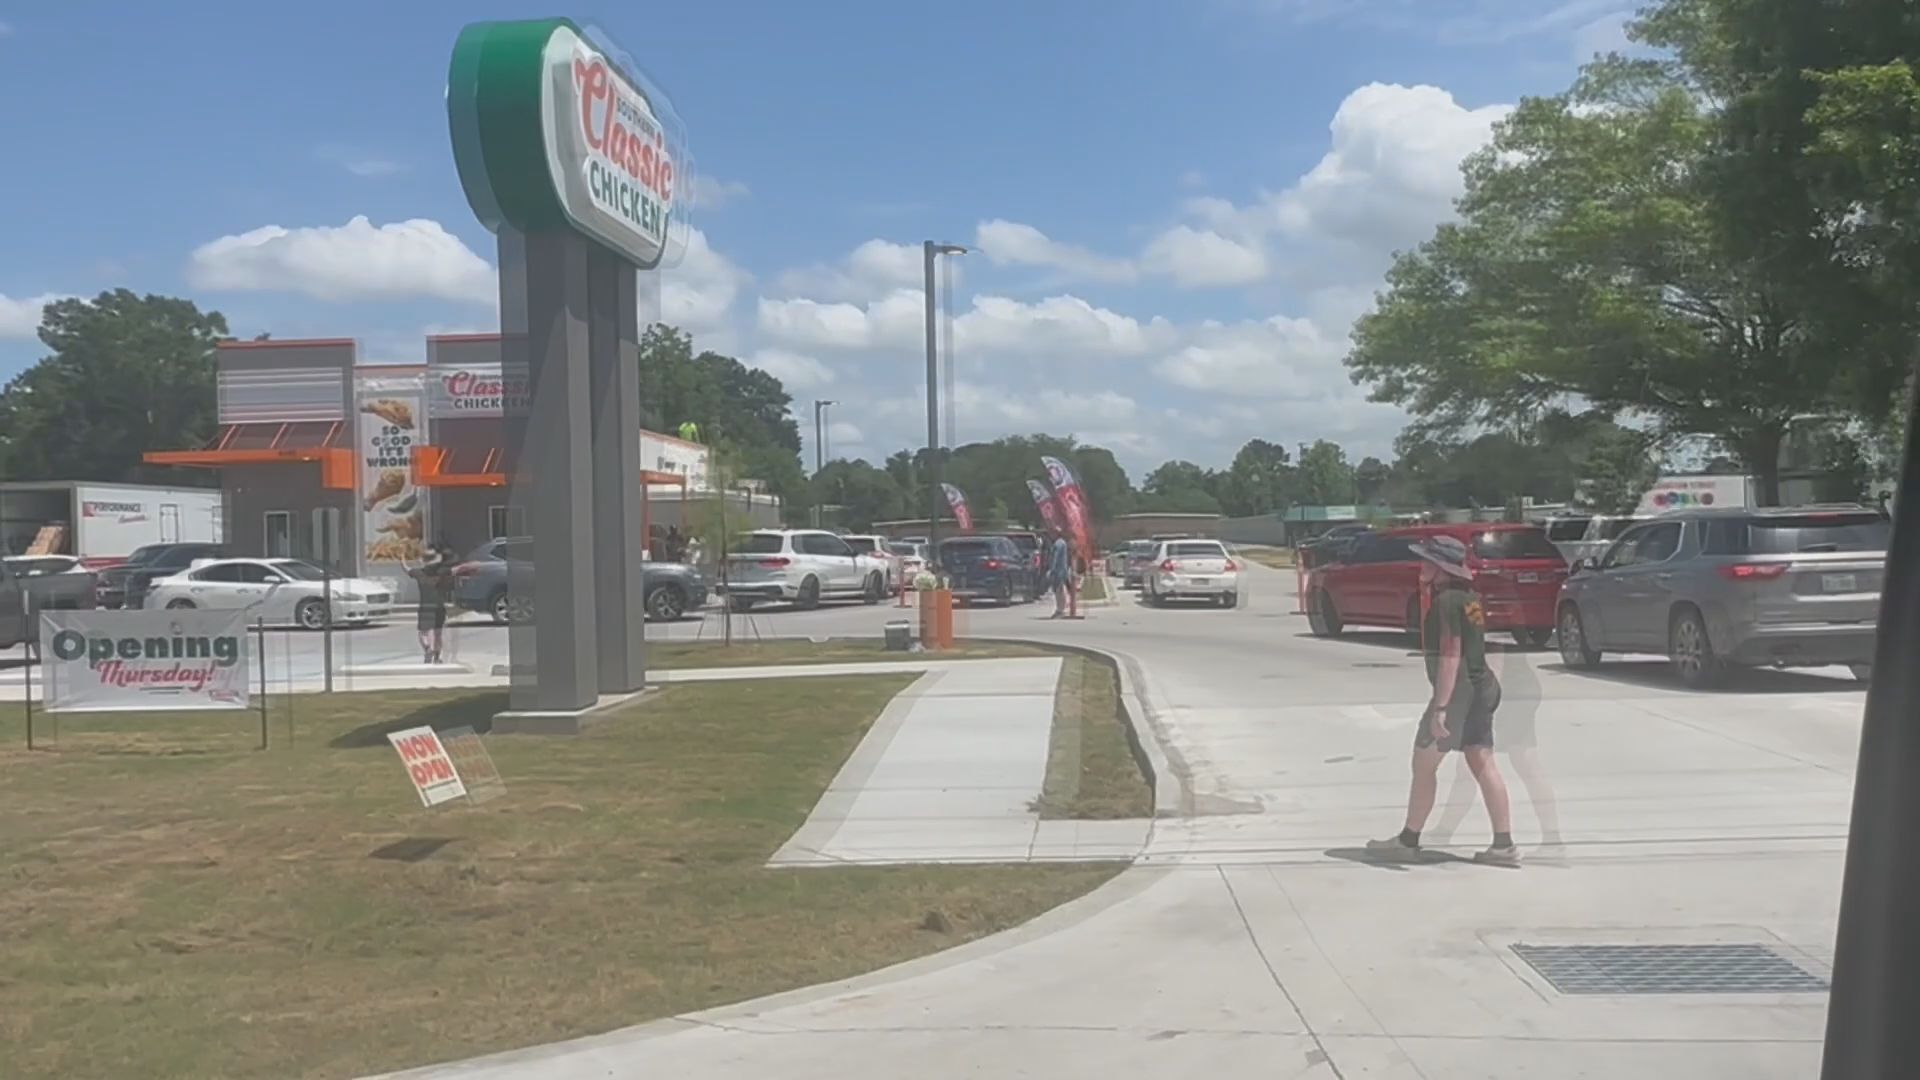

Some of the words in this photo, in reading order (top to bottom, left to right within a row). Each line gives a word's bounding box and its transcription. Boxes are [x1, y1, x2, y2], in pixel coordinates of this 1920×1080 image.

[575, 58, 672, 201] Classic
[590, 159, 662, 240] CHICKEN
[441, 371, 503, 397] Clas
[454, 398, 503, 409] CHICK
[382, 426, 400, 436] SO
[53, 622, 238, 669] Opening
[98, 660, 216, 691] Thursday!
[395, 733, 440, 762] NOW
[411, 755, 455, 786] OPEN
